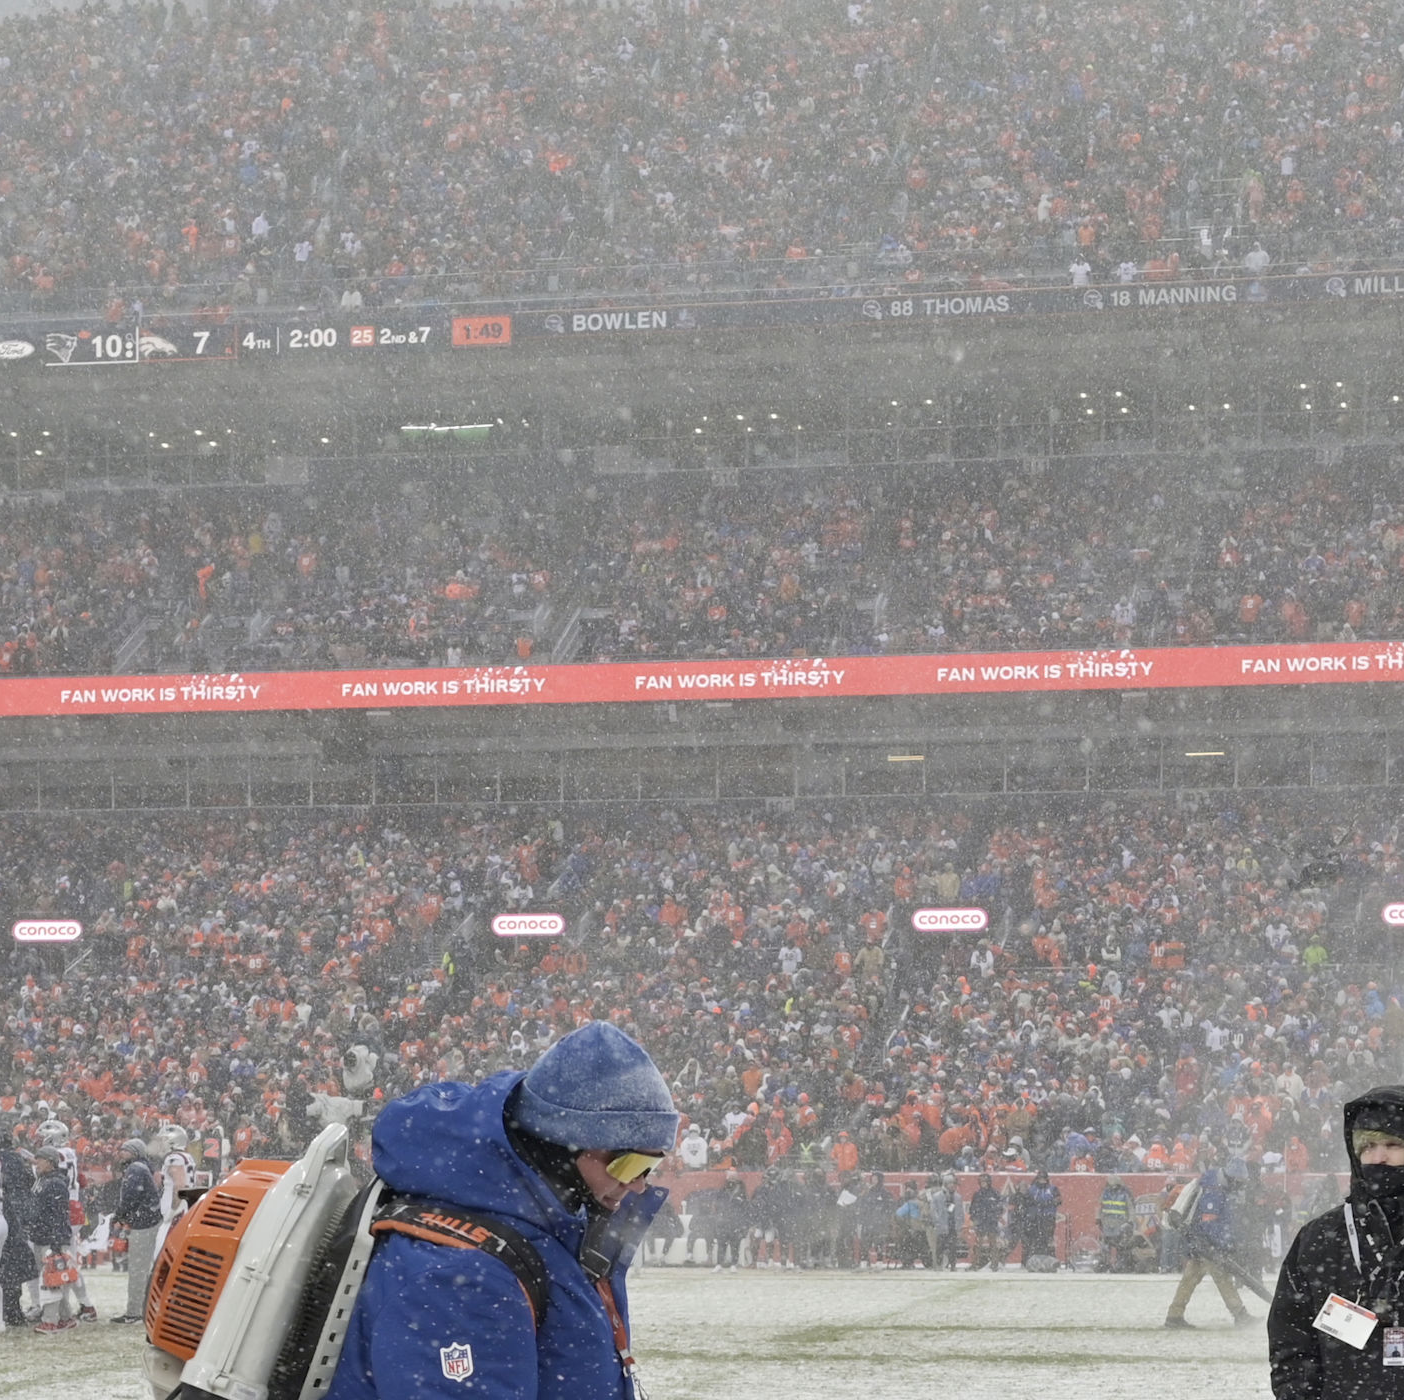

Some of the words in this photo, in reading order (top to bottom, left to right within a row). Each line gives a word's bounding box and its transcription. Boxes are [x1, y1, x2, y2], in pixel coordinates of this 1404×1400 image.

[1110, 290, 1131, 307] 18
[1138, 285, 1237, 305] MANNING
[890, 300, 913, 317] 88
[923, 295, 1010, 315] THOMAS
[572, 311, 667, 332] BOWLEN
[242, 331, 271, 349] 4TH
[289, 328, 337, 348] 2:00
[352, 329, 373, 344] 25
[462, 322, 503, 340] 1:49
[91, 335, 122, 358] 10
[193, 331, 210, 355] 7
[937, 668, 976, 681] FAN
[980, 665, 1040, 680] WORK
[1043, 665, 1063, 678] IS
[1065, 660, 1153, 678] THIRSTY
[1241, 659, 1281, 673] FAN
[1286, 657, 1347, 671] WORK
[1351, 656, 1371, 670] IS
[341, 683, 378, 696] FAN
[382, 681, 438, 695] WORK
[441, 681, 460, 694] IS
[462, 676, 546, 694] THIRSTY
[635, 676, 673, 689] FAN
[677, 674, 735, 688] WORK
[738, 673, 758, 686] IS
[760, 668, 845, 686] THIRSTY
[60, 690, 97, 703] FAN
[100, 688, 156, 702] WORK
[159, 688, 177, 701] IS
[180, 684, 261, 701] THIRSTY
[377, 923, 383, 932] 2
[498, 920, 558, 930] conoco
[918, 914, 981, 925] conoco
[19, 926, 77, 936] conoco
[1154, 947, 1164, 957] 10
[1138, 982, 1145, 993] 7
[843, 1031, 850, 1041] 2
[703, 1129, 711, 1140] 7
[204, 1139, 220, 1158] 2
[447, 1360, 469, 1375] NFL
